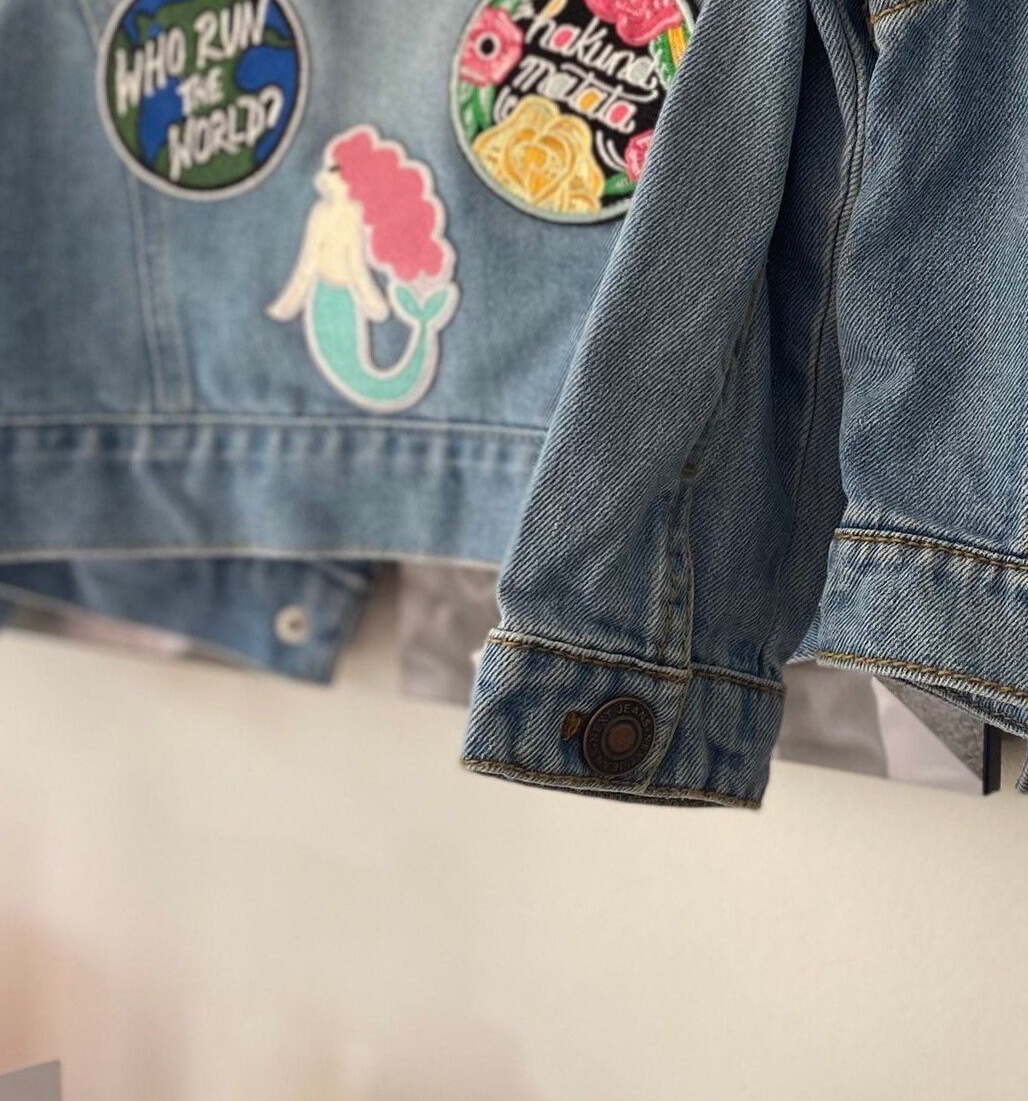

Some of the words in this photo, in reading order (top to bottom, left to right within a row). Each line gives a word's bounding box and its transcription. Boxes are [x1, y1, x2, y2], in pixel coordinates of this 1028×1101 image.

[115, 27, 187, 117] WHO
[176, 67, 224, 116] THE
[168, 85, 284, 182] WORLD?
